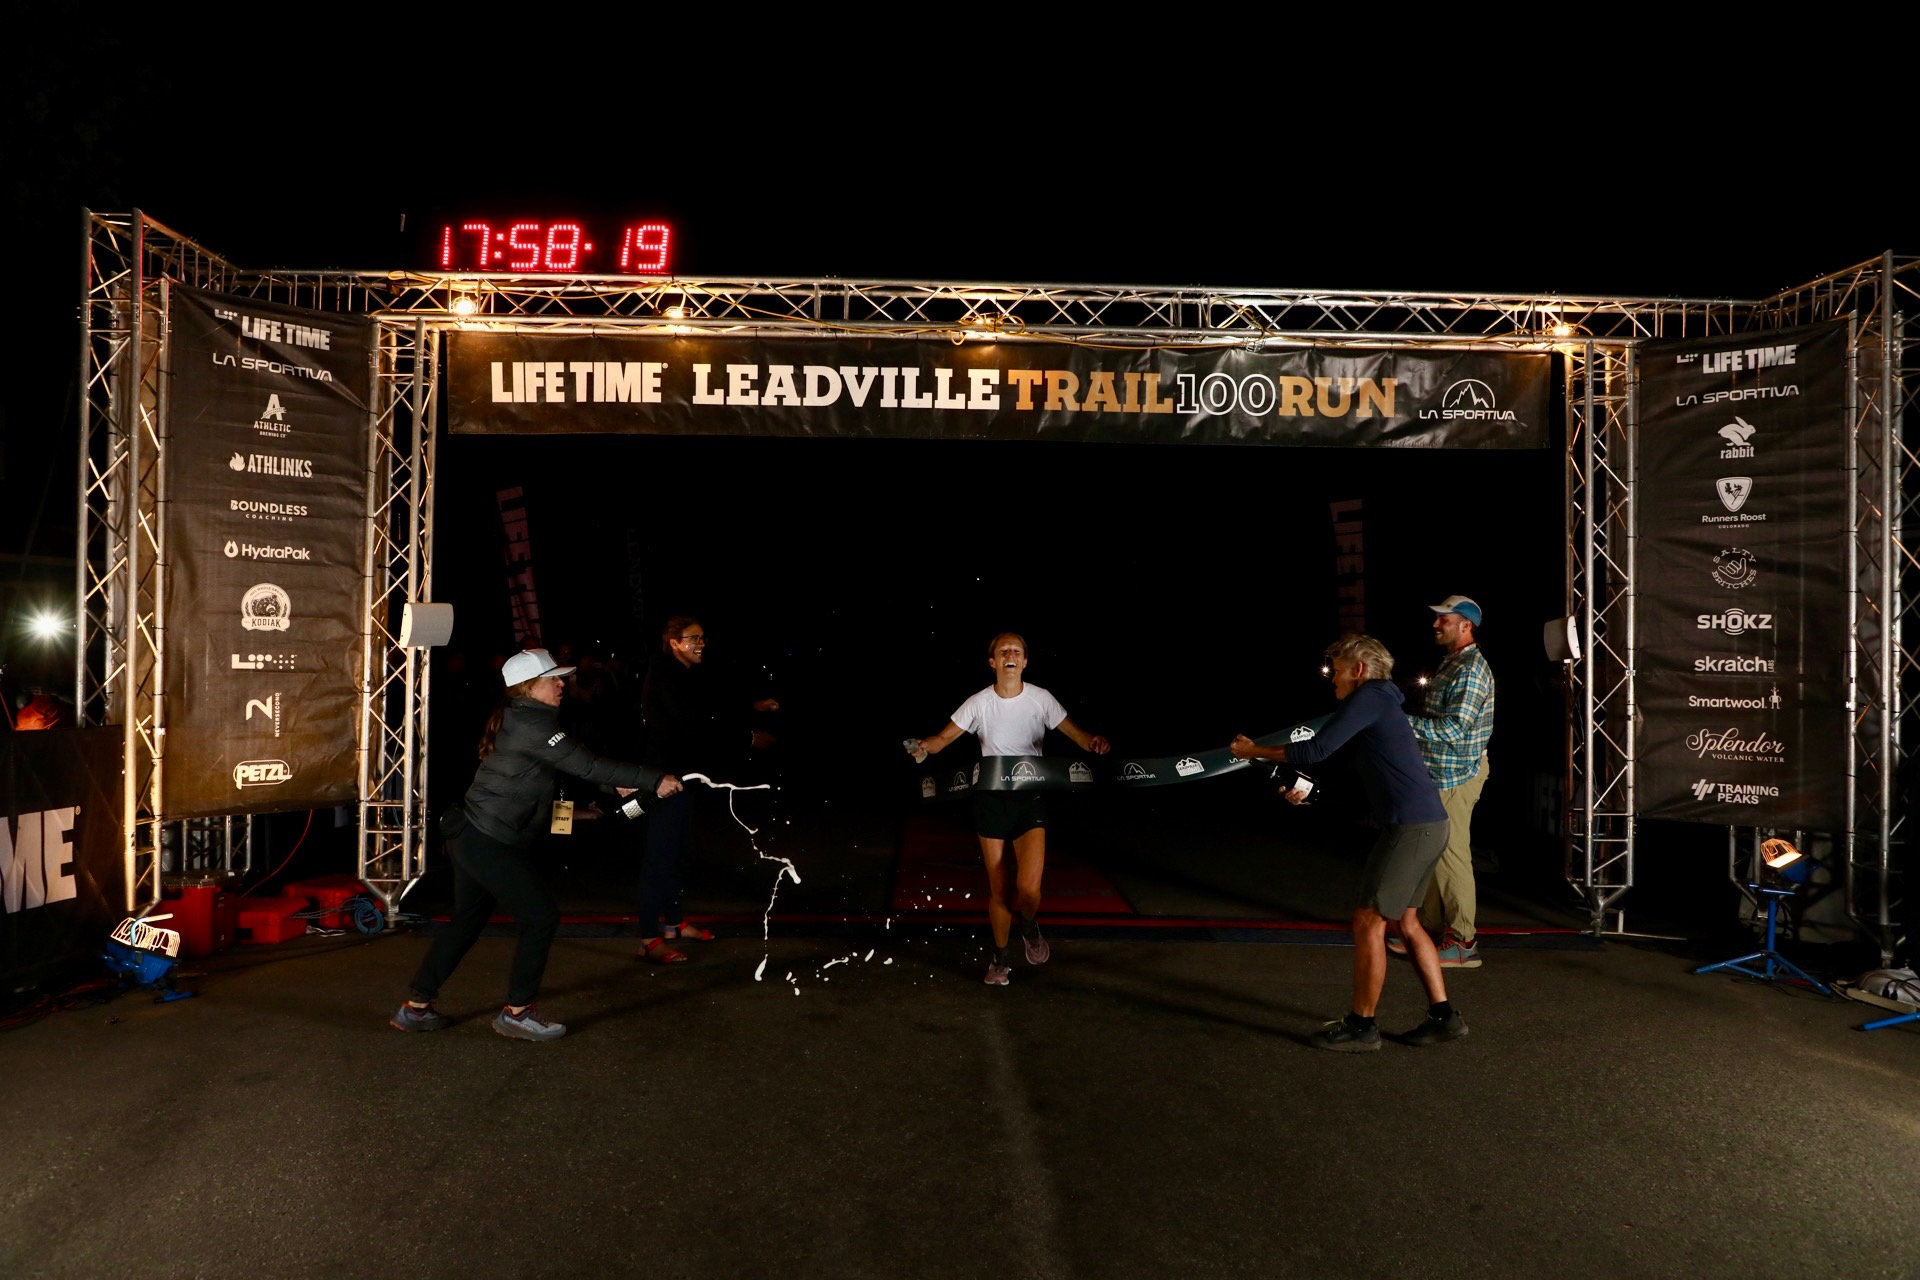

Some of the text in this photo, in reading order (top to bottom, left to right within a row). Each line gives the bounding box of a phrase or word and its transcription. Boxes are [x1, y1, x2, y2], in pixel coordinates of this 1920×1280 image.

[213, 353, 333, 382] LA SPORTIVA
[692, 363, 1000, 411] LEADVILLE
[1008, 370, 1175, 414] TRAIL
[1176, 373, 1277, 417] 100
[1278, 376, 1399, 418] RUN
[1676, 384, 1800, 407] LA SPORTIVA
[1419, 409, 1516, 420] LA SPORTIVA
[253, 420, 292, 433] ATHLETIC
[1720, 446, 1755, 460] rabbit
[247, 453, 313, 478] ATHLINKS
[230, 499, 308, 517] BOUNDLESS
[245, 514, 294, 522] COACHING
[1702, 512, 1767, 523] Runners Roost
[241, 543, 311, 561] HydraPak
[1712, 547, 1757, 564] SALTY
[1711, 569, 1757, 589] BRITCHES
[251, 618, 281, 628] KODIAK
[1696, 612, 1773, 631] SHOKZ
[1694, 656, 1768, 672] skratch
[274, 692, 282, 738] NEVERSECOND
[1686, 727, 1785, 758] Splendor
[1711, 753, 1785, 763] VOLCANIC WATER
[235, 762, 293, 791] PETZL
[1717, 783, 1779, 797] TRAINING
[1717, 793, 1759, 805] PEAKS
